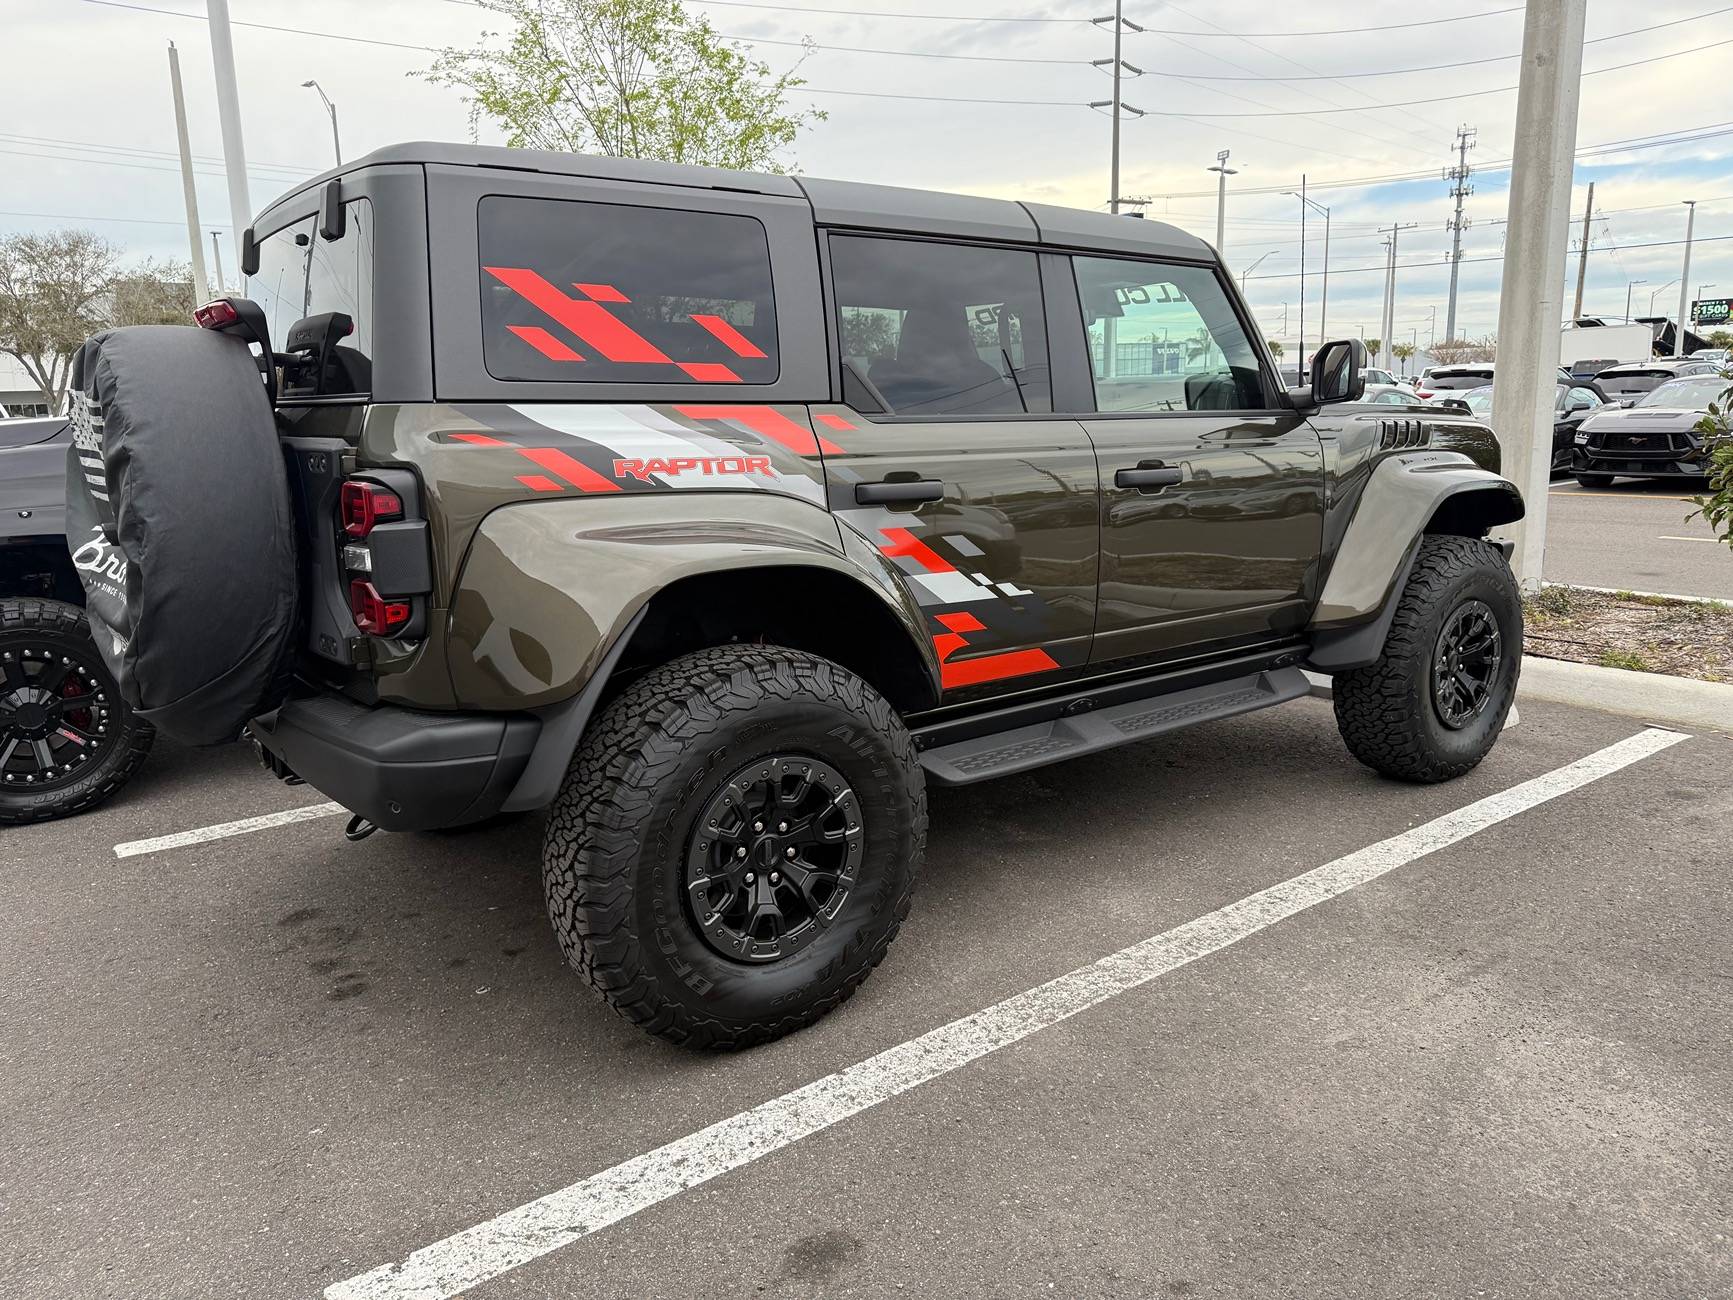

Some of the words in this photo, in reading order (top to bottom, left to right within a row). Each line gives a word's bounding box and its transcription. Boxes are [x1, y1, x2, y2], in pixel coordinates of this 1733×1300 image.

[1693, 304, 1728, 314] $1500
[612, 455, 781, 485] RAPTOR
[101, 582, 118, 597] SINCE
